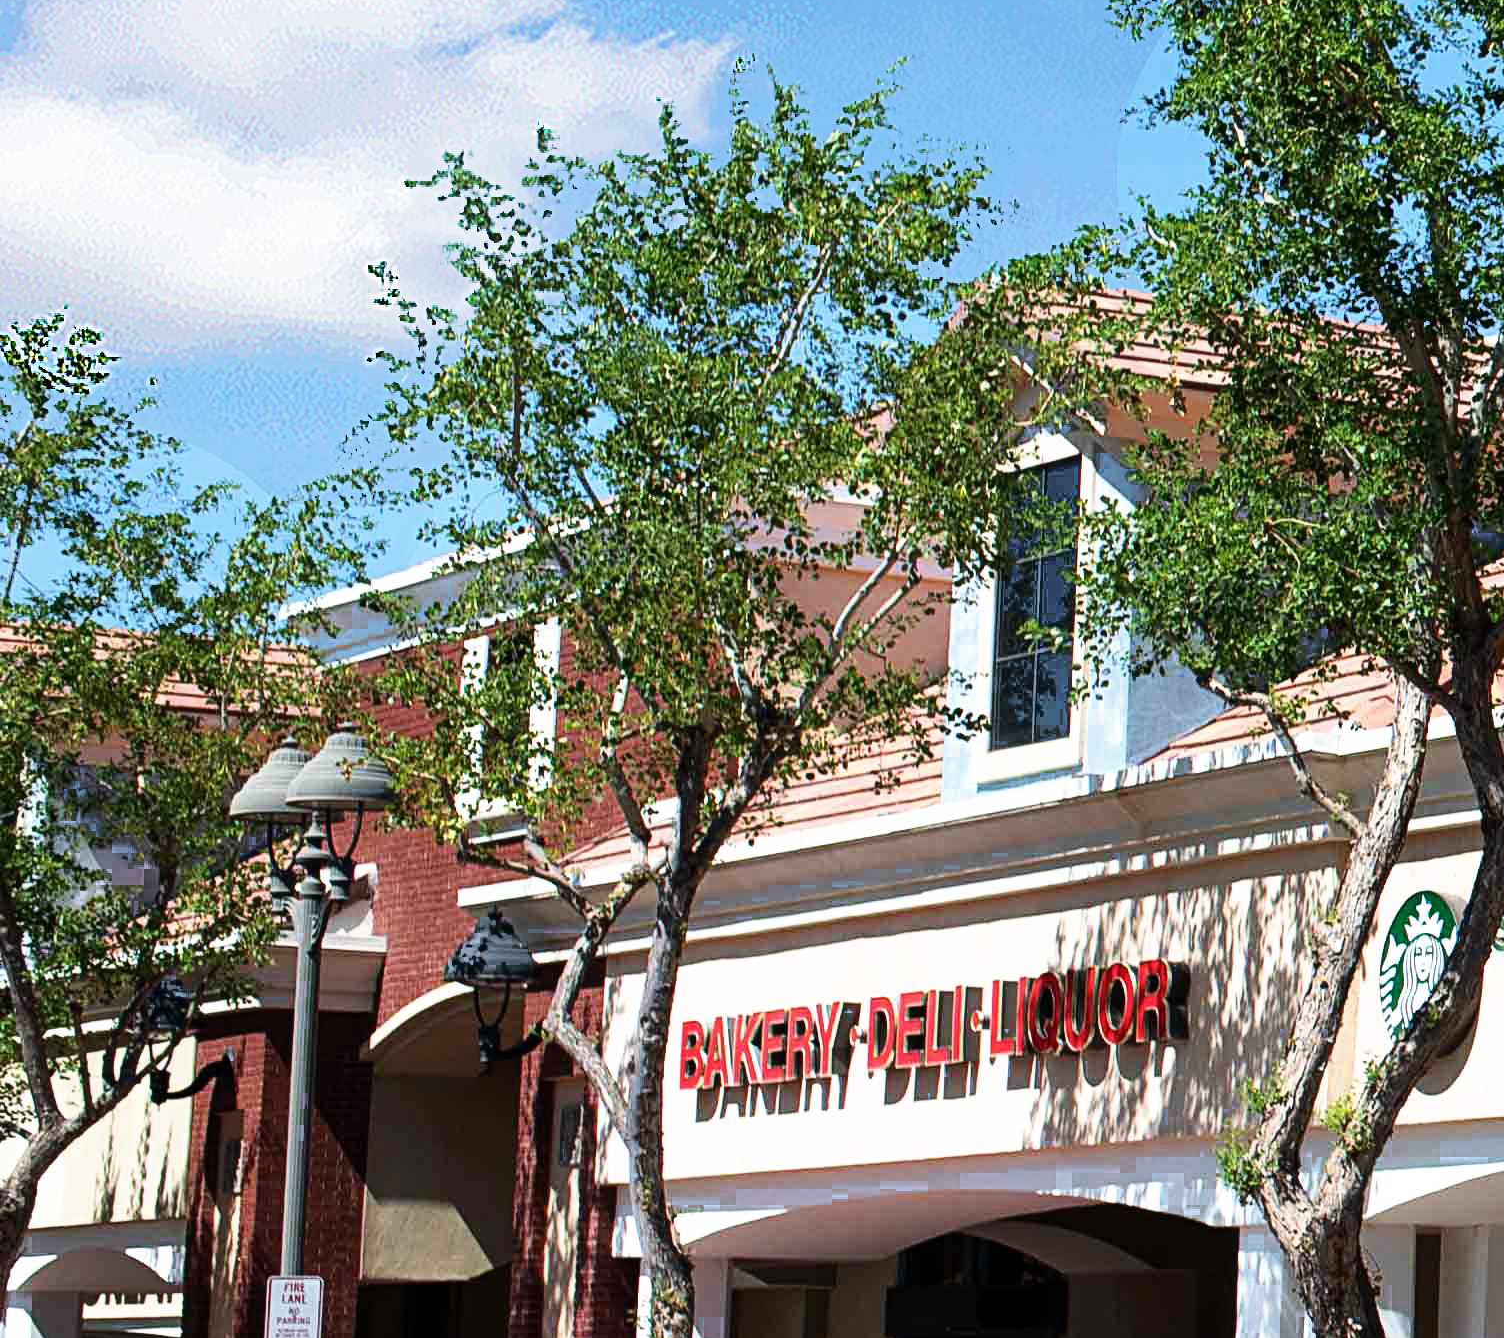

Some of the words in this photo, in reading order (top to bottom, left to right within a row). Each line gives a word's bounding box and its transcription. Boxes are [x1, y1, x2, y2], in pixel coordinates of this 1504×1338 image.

[679, 1001, 841, 1089] BAKERY
[866, 985, 965, 1070] DELI
[989, 959, 1169, 1055] LIQUOR
[283, 1282, 305, 1293] FIRE
[281, 1294, 307, 1304] LANE
[276, 1317, 311, 1326] PARKING
